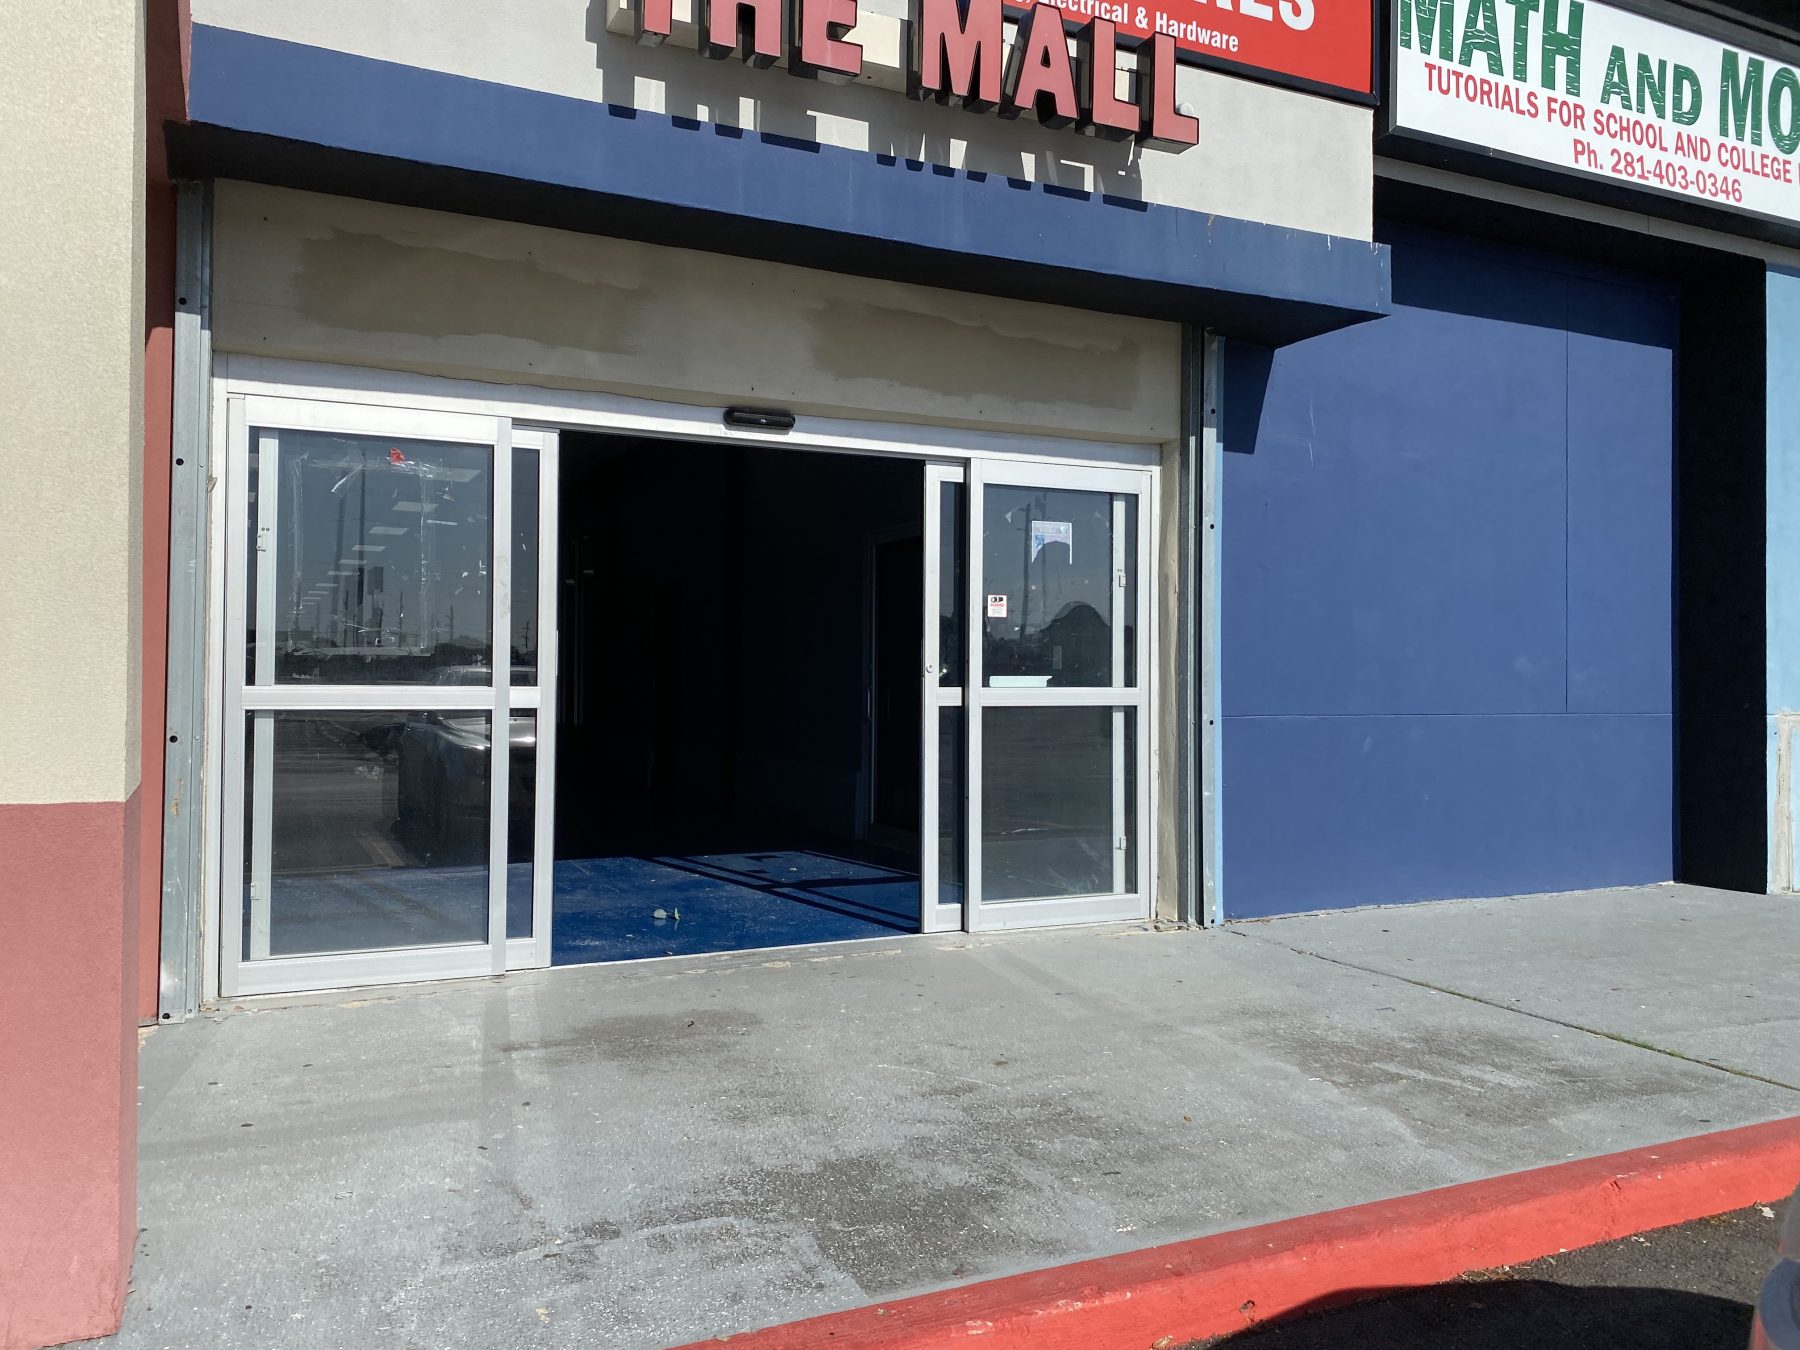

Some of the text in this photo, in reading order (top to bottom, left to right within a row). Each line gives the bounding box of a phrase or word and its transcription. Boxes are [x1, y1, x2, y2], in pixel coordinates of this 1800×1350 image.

[1134, 4, 1149, 29] &
[1155, 10, 1239, 52] Hardware
[921, 0, 1200, 145] MALL
[1600, 44, 1702, 126] AND
[1424, 61, 1539, 119] TUTORIALS
[1546, 96, 1586, 131] FOR
[1593, 108, 1669, 153] SCHOOL
[1674, 130, 1711, 162] AND
[1717, 142, 1793, 184] COLLEGE
[1573, 138, 1743, 203] Ph. 281-403-0346
